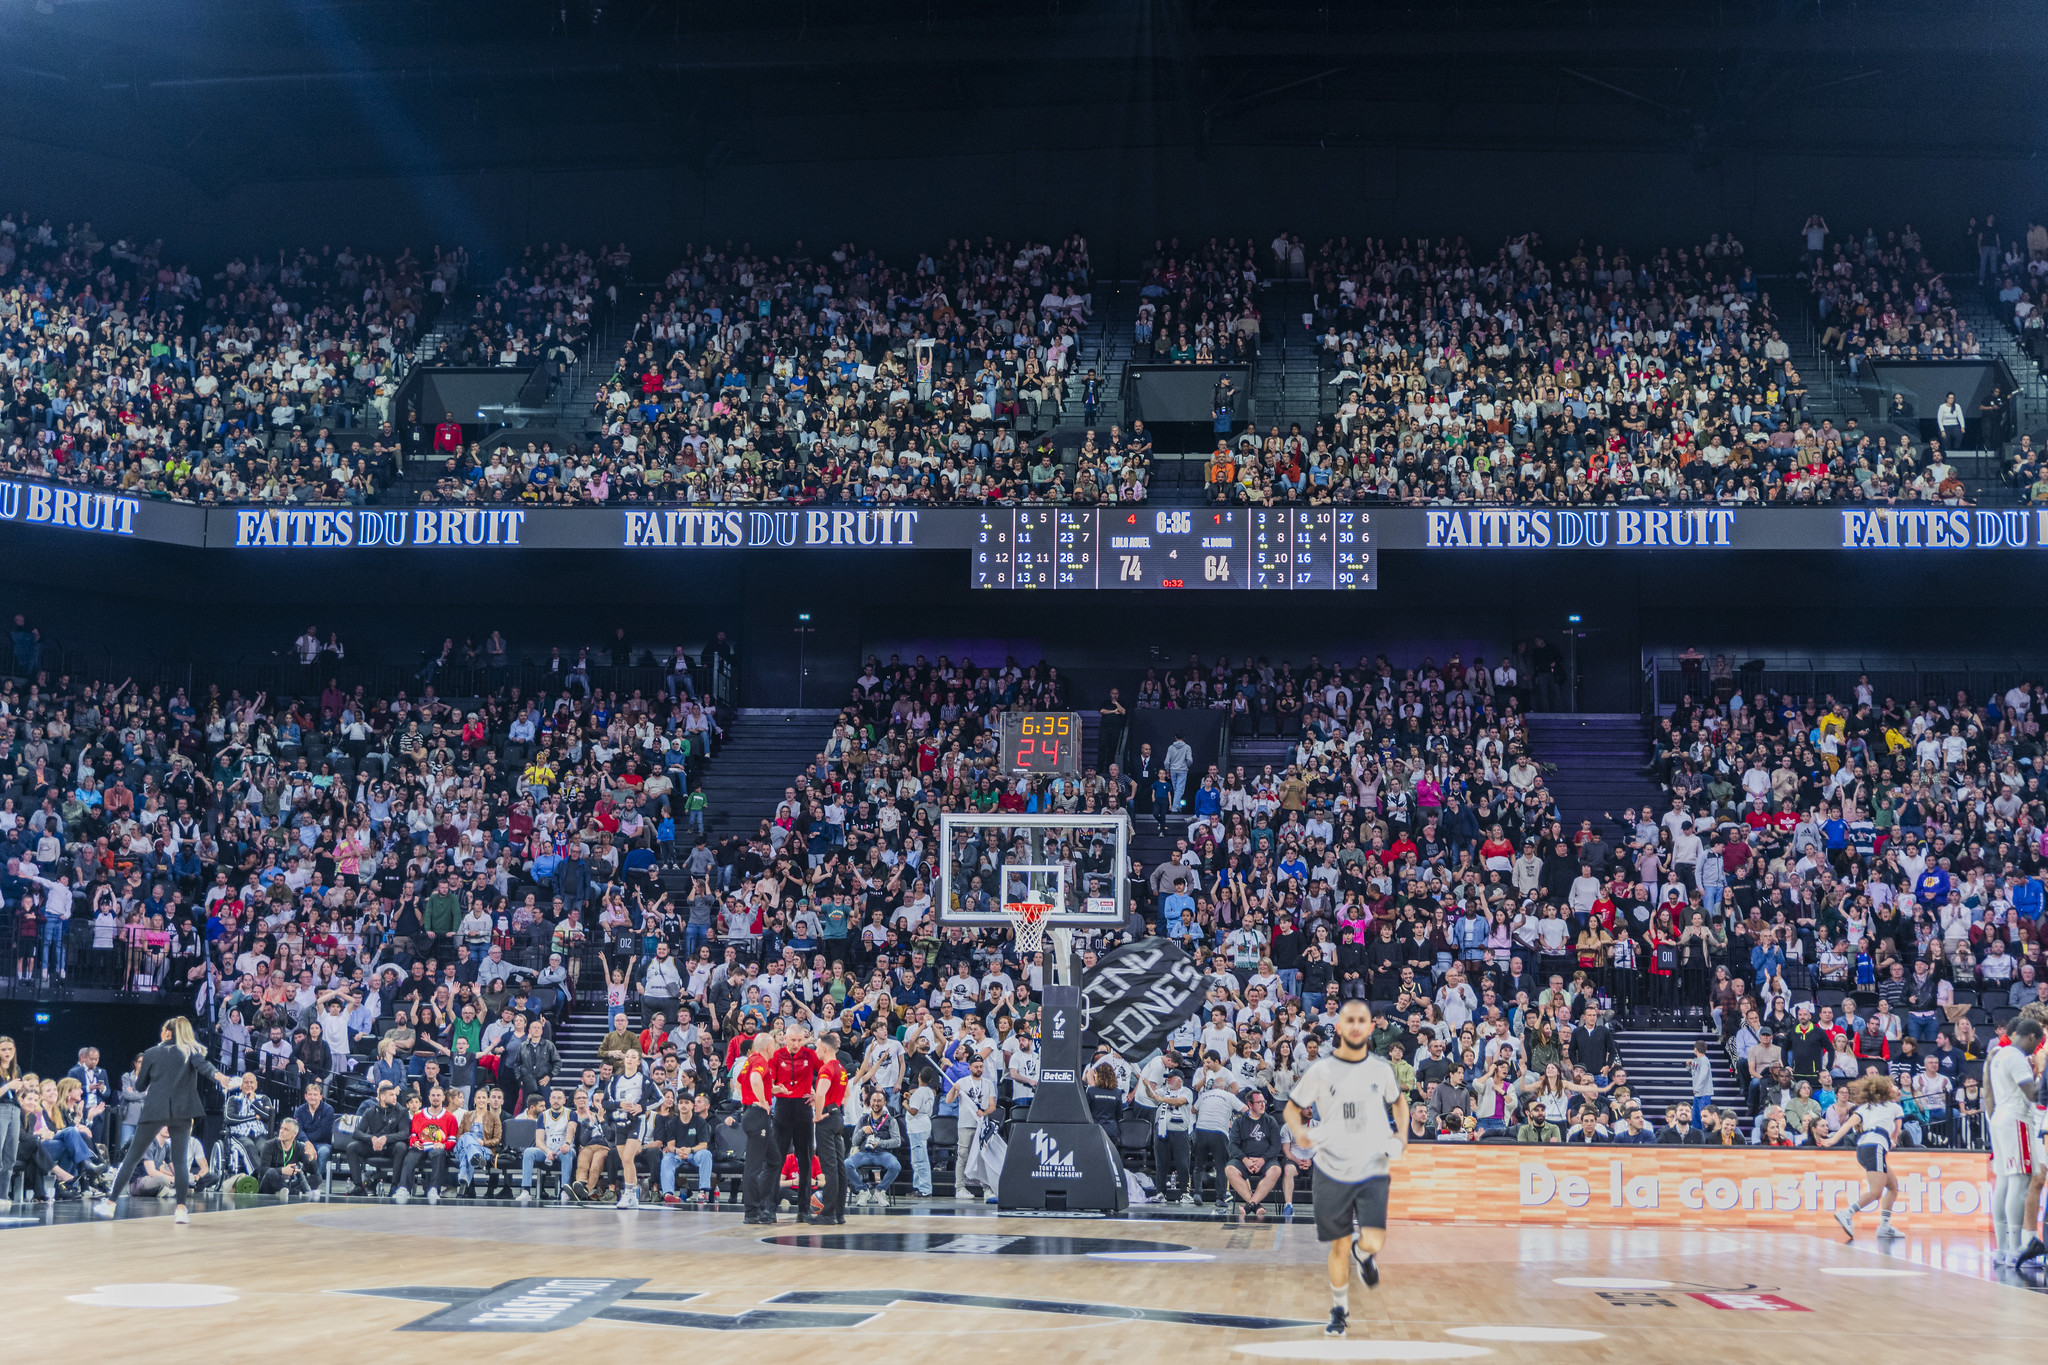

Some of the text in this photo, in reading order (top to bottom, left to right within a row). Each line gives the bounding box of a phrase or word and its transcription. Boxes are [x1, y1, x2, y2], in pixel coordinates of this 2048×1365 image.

[26, 484, 139, 535] BRUIT
[981, 513, 987, 523] 1
[1021, 513, 1047, 523] 8 5
[1060, 513, 1090, 523] 21 7
[1126, 514, 1136, 524] 4
[1214, 514, 1220, 524] 1
[1258, 513, 1285, 523] 3 2
[1300, 513, 1330, 523] 8 10
[1339, 513, 1369, 523] 27 8
[236, 510, 525, 546] FAITES DU BRUIT
[623, 510, 918, 547] FAITES DU BRUIT
[1426, 510, 1735, 547] FAITES DU BRUIT
[1842, 510, 1971, 548] FAITES
[1975, 511, 2030, 548] DU
[980, 533, 1006, 543] 3 8
[1018, 533, 1031, 543] 11
[1060, 533, 1090, 543] 23 7
[1258, 533, 1284, 543] 4 8
[1297, 533, 1327, 543] 11 4
[1339, 533, 1369, 543] 30 6
[979, 553, 1008, 563] 6 12
[1017, 553, 1049, 563] 12 11
[1059, 553, 1089, 563] 28 8
[1169, 550, 1178, 559] 4
[1258, 553, 1288, 563] 5 10
[1297, 553, 1311, 563] 16
[1339, 553, 1369, 563] 34 9
[1120, 556, 1142, 581] 74
[1204, 556, 1230, 581] 64
[979, 573, 1005, 583] 7 8
[1017, 573, 1046, 583] 13 8
[1059, 573, 1073, 583] 34
[1258, 573, 1284, 583] 7 3
[1297, 573, 1311, 583] 17
[1339, 573, 1369, 583] 90 4
[1162, 579, 1184, 588] 0:32
[1022, 716, 1069, 736] 6:35
[1016, 739, 1059, 767] 24
[620, 938, 632, 948] 012
[1662, 951, 1672, 962] 011
[1097, 956, 1203, 1053] GONES
[1044, 1072, 1072, 1080] Betclic
[1519, 1162, 1590, 1207] De
[1610, 1161, 1661, 1209] la
